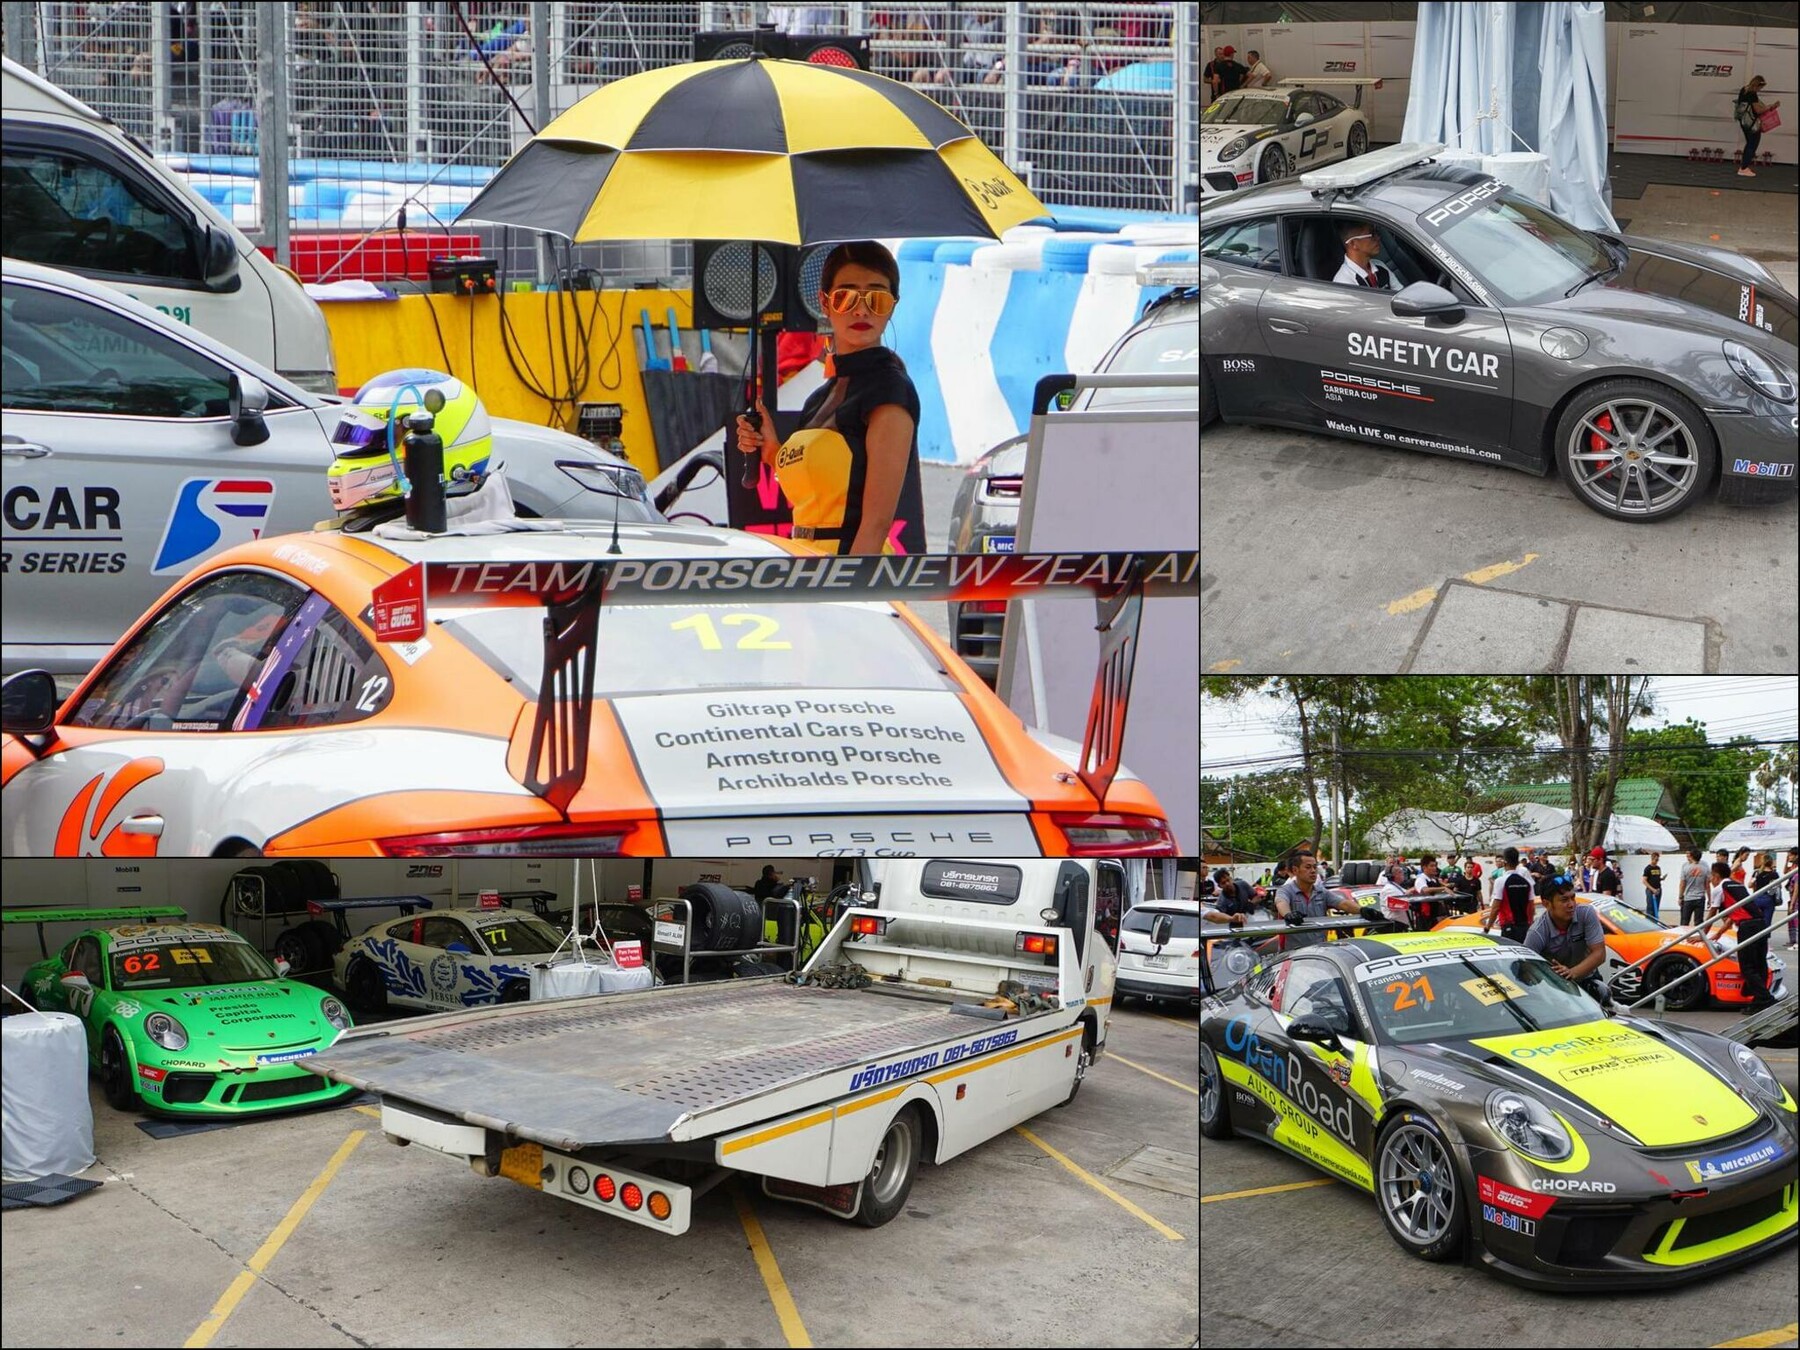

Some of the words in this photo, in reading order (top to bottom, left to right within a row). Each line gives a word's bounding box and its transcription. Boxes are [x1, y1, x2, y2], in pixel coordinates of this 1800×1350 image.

[1430, 242, 1488, 298] www.porsche.com
[1223, 359, 1256, 370] BOSS
[1347, 332, 1442, 369] SAFETY
[1446, 348, 1499, 379] CAR
[1320, 370, 1421, 396] PORSCHE
[1323, 384, 1360, 398] CARRERA
[1361, 391, 1378, 401] CUP
[1325, 392, 1343, 402] ASIA
[1326, 419, 1357, 434] Watch
[1359, 425, 1381, 439] LIVE
[1383, 432, 1396, 441] on
[1398, 435, 1501, 461] carreracupasia.com
[1733, 458, 1778, 477] Mobil
[3, 485, 122, 531] CAR
[20, 552, 127, 574] SERIES
[446, 561, 594, 593] TEAM
[606, 557, 863, 591] PORSCHE
[868, 555, 1008, 588] NEW
[671, 613, 792, 650] 12
[355, 675, 388, 712] 12
[706, 703, 791, 718] Giltrap
[799, 700, 896, 716] Porsche
[655, 723, 803, 748] Continental
[806, 722, 864, 738] Cars
[871, 722, 966, 743] Porsche
[706, 748, 838, 769] Armstrong
[844, 746, 941, 765] Porsche
[717, 773, 849, 792] Archibalds
[852, 771, 953, 788] Porsche
[726, 832, 993, 848] PORSCHE
[1357, 896, 1377, 908] 68
[116, 934, 242, 948] PORSCHE
[484, 928, 507, 945] 77
[124, 953, 160, 974] 62
[1366, 947, 1536, 974] PORSCHE
[1366, 974, 1403, 988] Francis
[1403, 969, 1422, 979] Tjia
[1385, 975, 1436, 1013] 21
[215, 1008, 261, 1018] Capital
[221, 1012, 296, 1025] Corporation
[942, 1029, 1019, 1064] 081-6875863
[1510, 1031, 1644, 1060] OpenRoad
[161, 1059, 206, 1068] CHOPARD
[270, 1051, 313, 1063] MICHELIN
[1570, 1061, 1619, 1077] TRANS
[1623, 1053, 1665, 1066] CHINA
[1225, 1014, 1356, 1147] OpenRoad
[1236, 1091, 1256, 1104] BOSS
[1248, 1074, 1276, 1105] AUTO
[1280, 1100, 1318, 1140] GROUP
[1721, 1145, 1775, 1172] MICHELIN
[1531, 1178, 1617, 1194] CHOPARD
[1483, 1204, 1520, 1232] Mobil
[1519, 1218, 1536, 1237] 1
